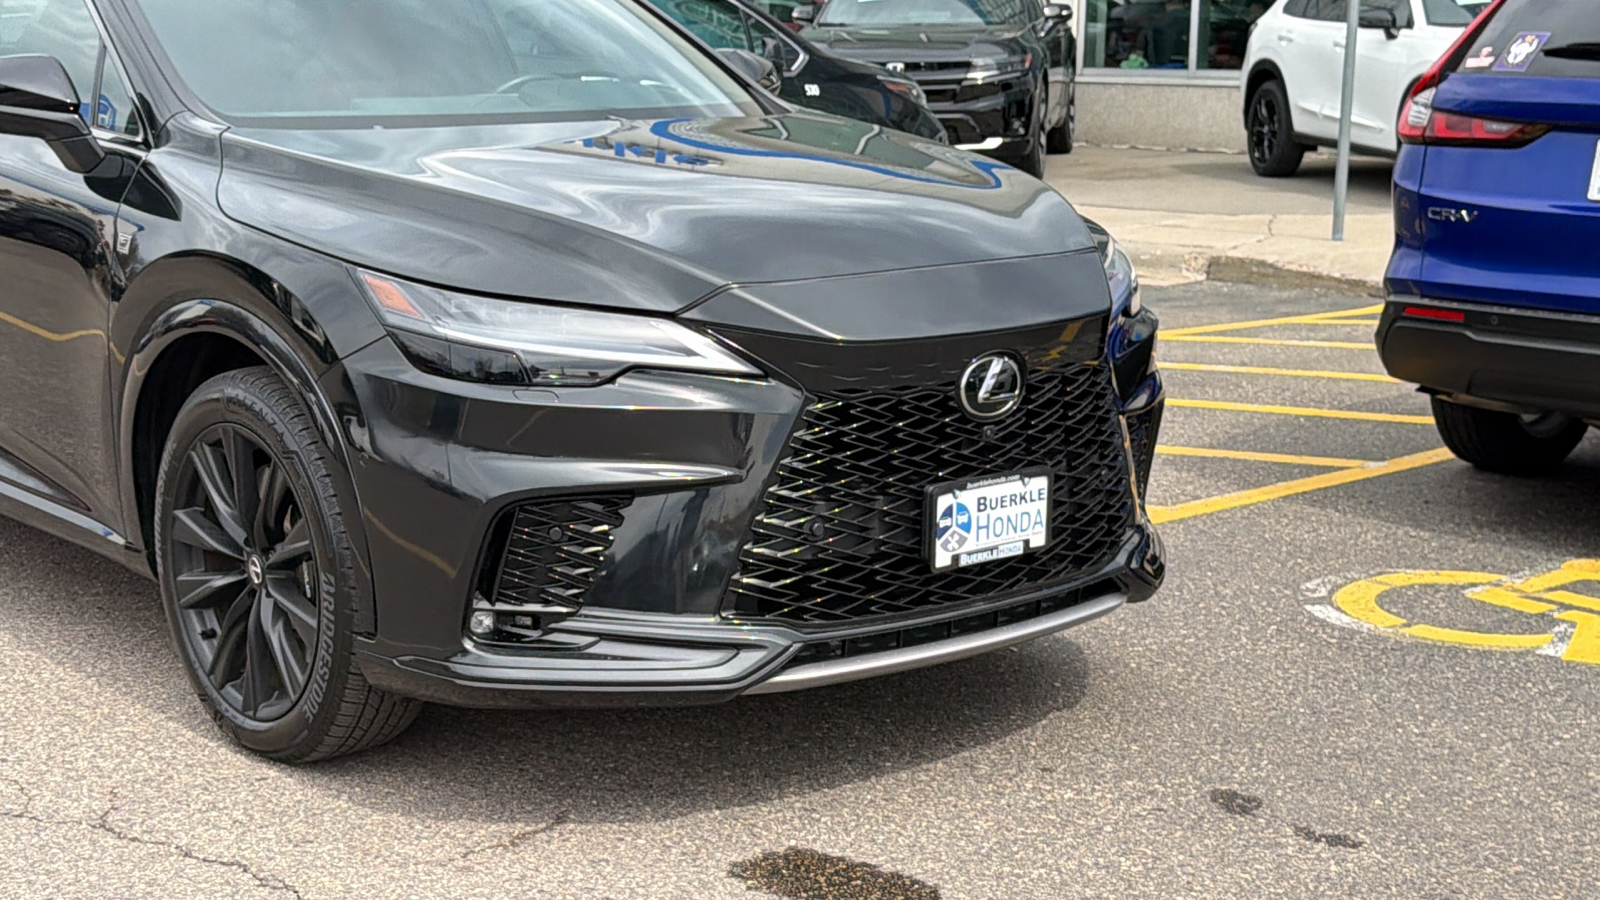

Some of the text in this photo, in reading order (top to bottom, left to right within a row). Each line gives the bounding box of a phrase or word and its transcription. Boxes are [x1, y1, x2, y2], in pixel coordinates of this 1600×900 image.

[977, 488, 1046, 512] BUERKLE
[976, 508, 1044, 542] HONDA
[960, 549, 998, 566] BUERKLE
[302, 571, 336, 723] BRIDGESTONE
